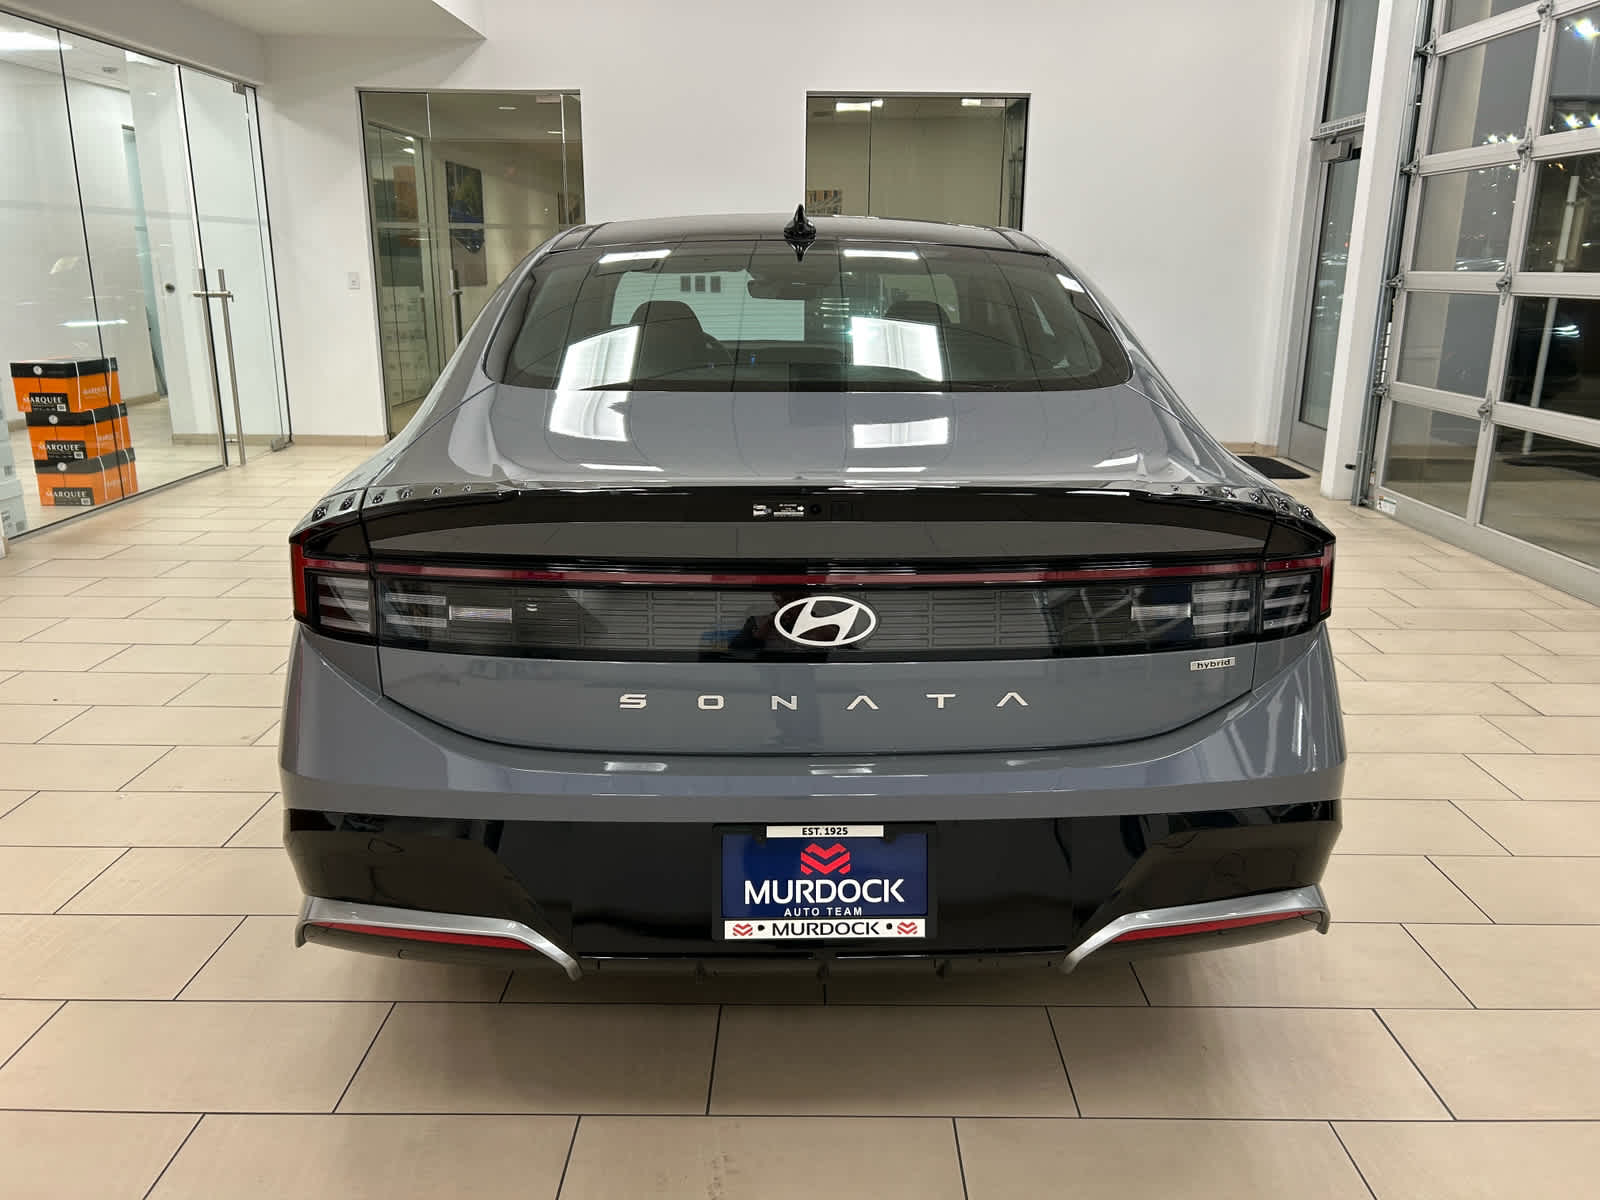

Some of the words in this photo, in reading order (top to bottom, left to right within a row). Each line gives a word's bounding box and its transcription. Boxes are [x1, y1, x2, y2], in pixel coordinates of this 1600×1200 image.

[1196, 658, 1231, 669] hybrid
[619, 692, 1029, 711] SONATA
[802, 827, 822, 836] EST.
[824, 826, 849, 836] 1925
[744, 878, 905, 905] MURDOCK
[784, 907, 820, 917] AUTO
[827, 906, 863, 916] TEAM
[772, 921, 880, 936] MURDOCK
